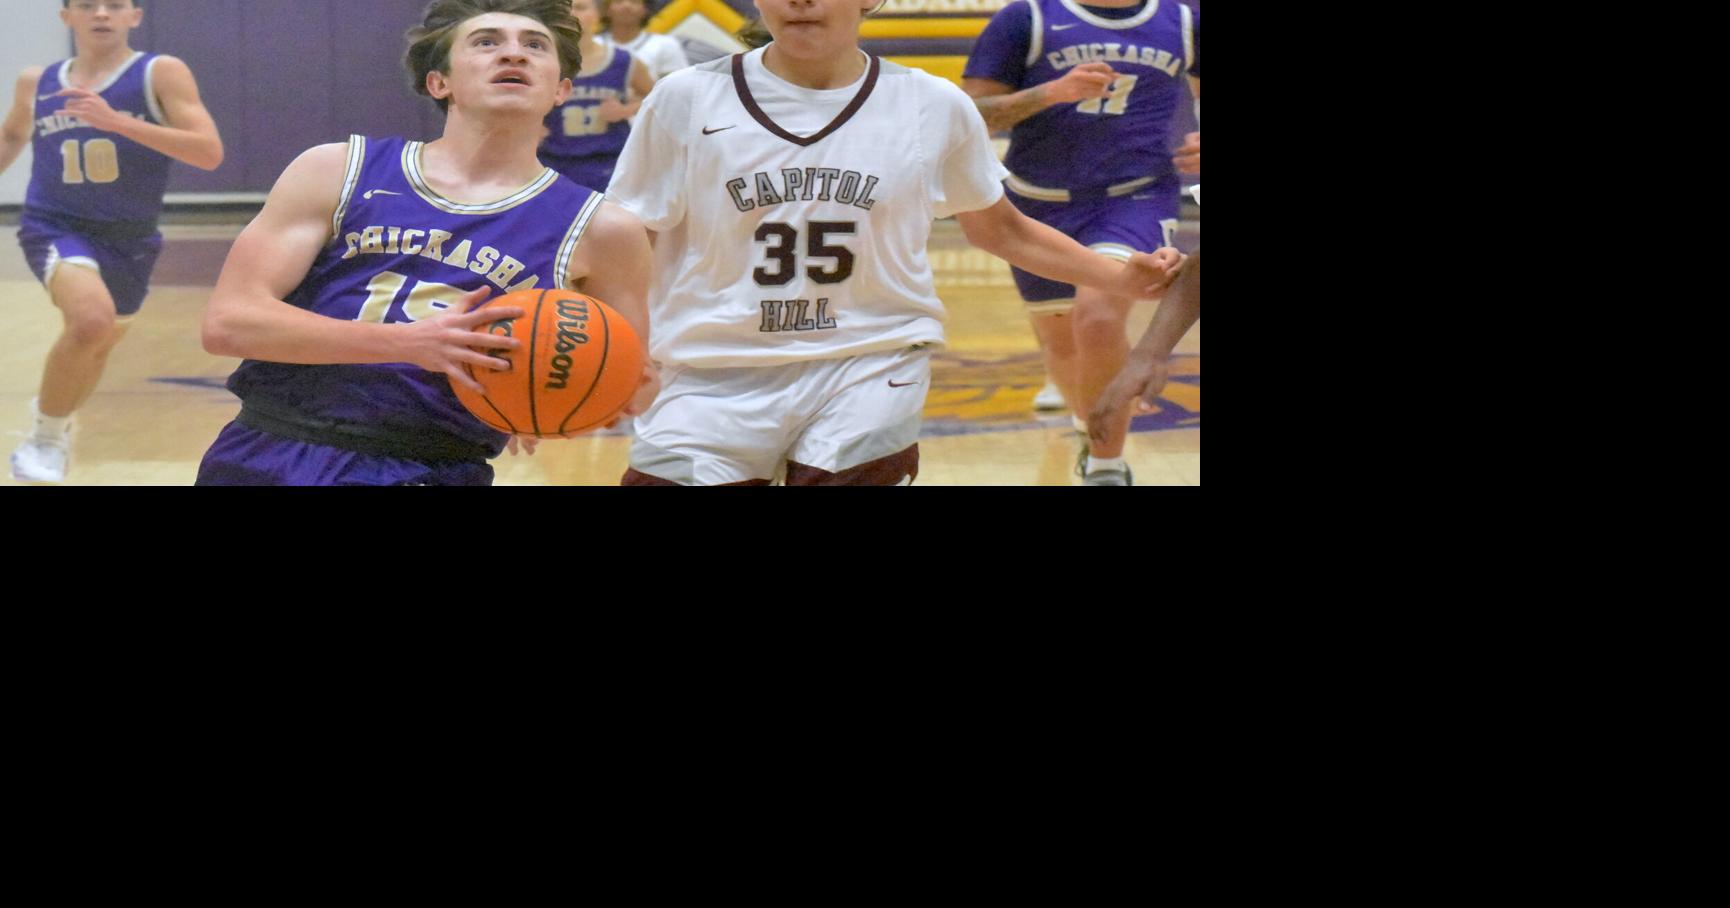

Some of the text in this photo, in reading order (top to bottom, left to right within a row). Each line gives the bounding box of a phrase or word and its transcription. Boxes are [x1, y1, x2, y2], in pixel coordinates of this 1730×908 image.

[1046, 43, 1182, 78] CHICKASHA
[61, 138, 119, 184] 10
[726, 167, 880, 212] CAPITOL
[752, 220, 858, 287] 35
[759, 298, 837, 333] HILL
[544, 298, 590, 390] Wilson
